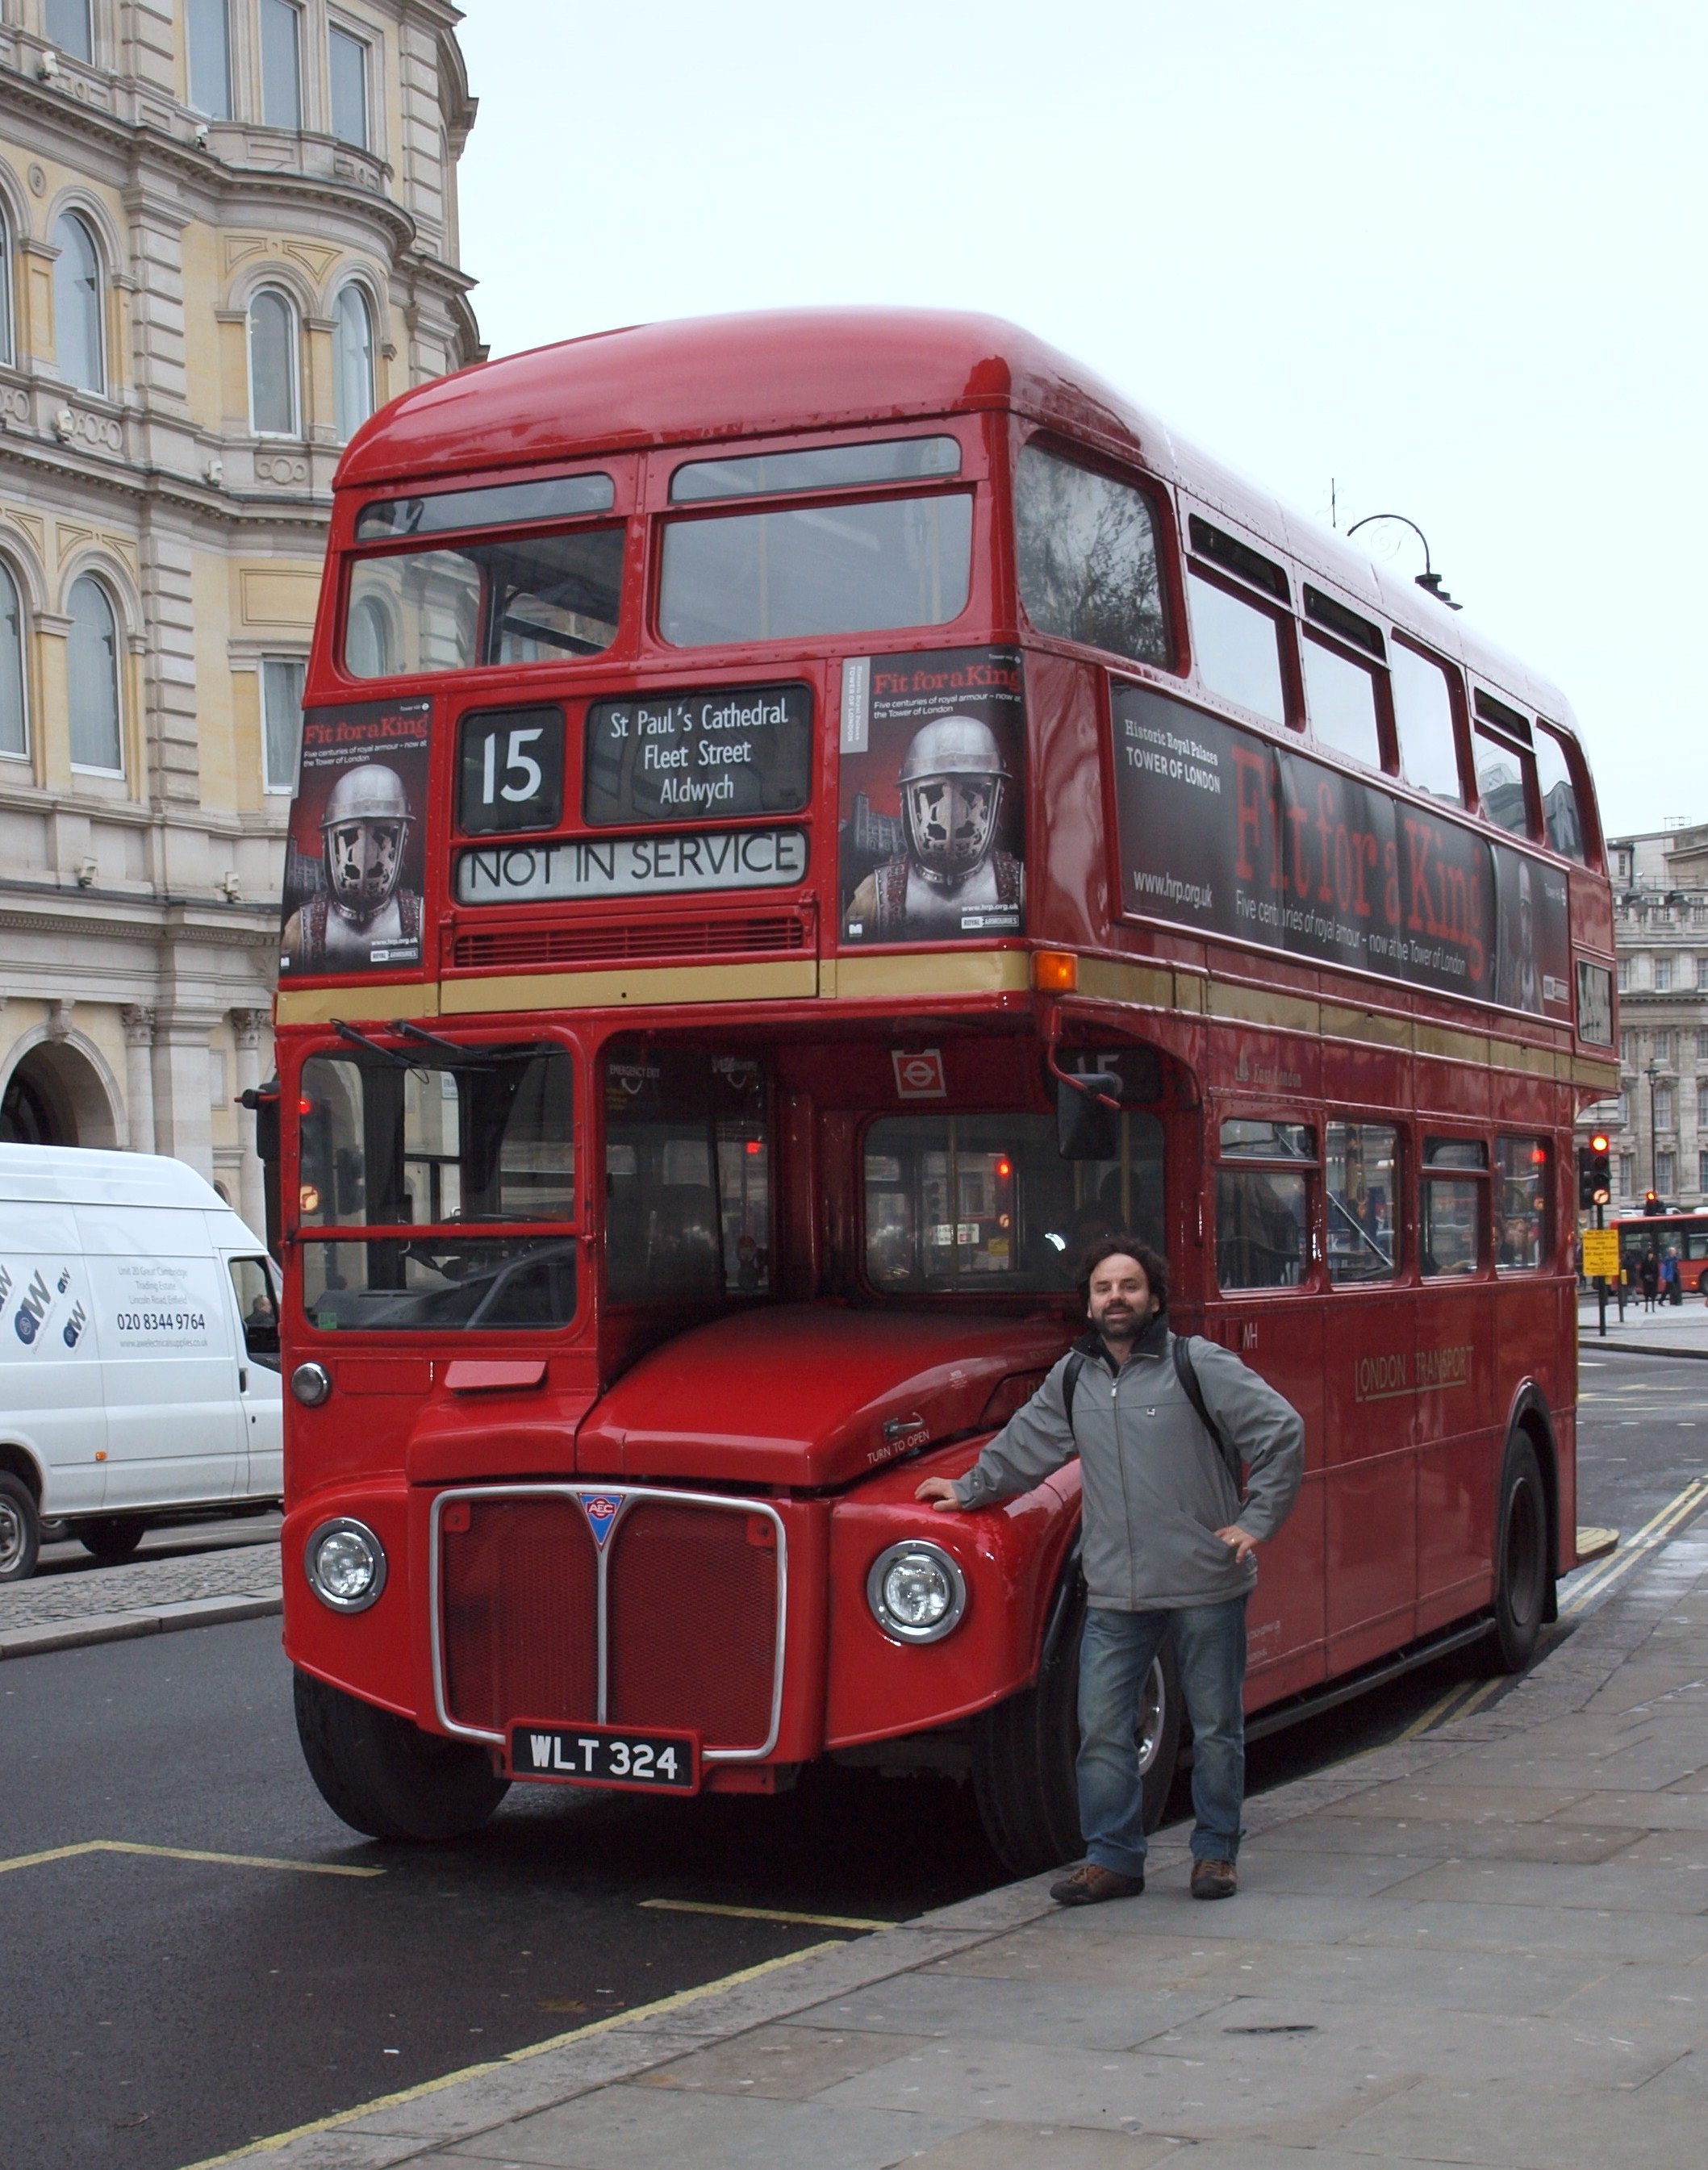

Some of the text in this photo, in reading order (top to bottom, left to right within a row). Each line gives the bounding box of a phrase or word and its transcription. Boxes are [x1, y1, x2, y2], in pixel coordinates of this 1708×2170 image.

[874, 664, 1022, 695] Fit for a King
[848, 695, 855, 706] OF
[874, 701, 891, 709] Five
[892, 698, 927, 707] centuries
[928, 696, 938, 704] of
[938, 695, 958, 703] royal
[958, 693, 988, 702] armour
[874, 705, 954, 720] the Tower of London
[304, 714, 428, 745] Fit for a King
[611, 698, 788, 739] St Paul's Cathedral
[303, 750, 318, 758] Five
[318, 747, 349, 757] centuries
[349, 746, 357, 754] of
[357, 745, 374, 753] royal
[374, 743, 399, 752] armour
[645, 740, 751, 770] Fleet Street
[1125, 719, 1218, 766] Historic Royal Palaces
[315, 758, 335, 766] Tower
[344, 754, 370, 764] London
[482, 728, 544, 804] 15
[1126, 746, 1221, 794] TOWER OF LONDON
[660, 774, 733, 807] Aldwych
[471, 833, 798, 887] NOT IN SERVICE
[1231, 745, 1485, 981] Fit for a King
[1134, 870, 1212, 909] www.hrp.org.uk
[963, 903, 1018, 912] www.hrp.org.uk
[1236, 889, 1256, 920] Five
[1305, 908, 1314, 933] of
[1315, 916, 1335, 942] royal
[1369, 934, 1389, 954] now
[1409, 939, 1432, 966] Tower
[1433, 946, 1441, 968] of
[1441, 949, 1466, 976] London
[646, 1067, 660, 1078] EXIT
[117, 1313, 205, 1329] 020 8344 9764
[1355, 1346, 1474, 1402] LONDON TRANSPORT
[867, 1429, 929, 1464] TURN TO OPEN
[588, 1504, 614, 1513] AEC
[530, 1734, 678, 1780] WLT 324
